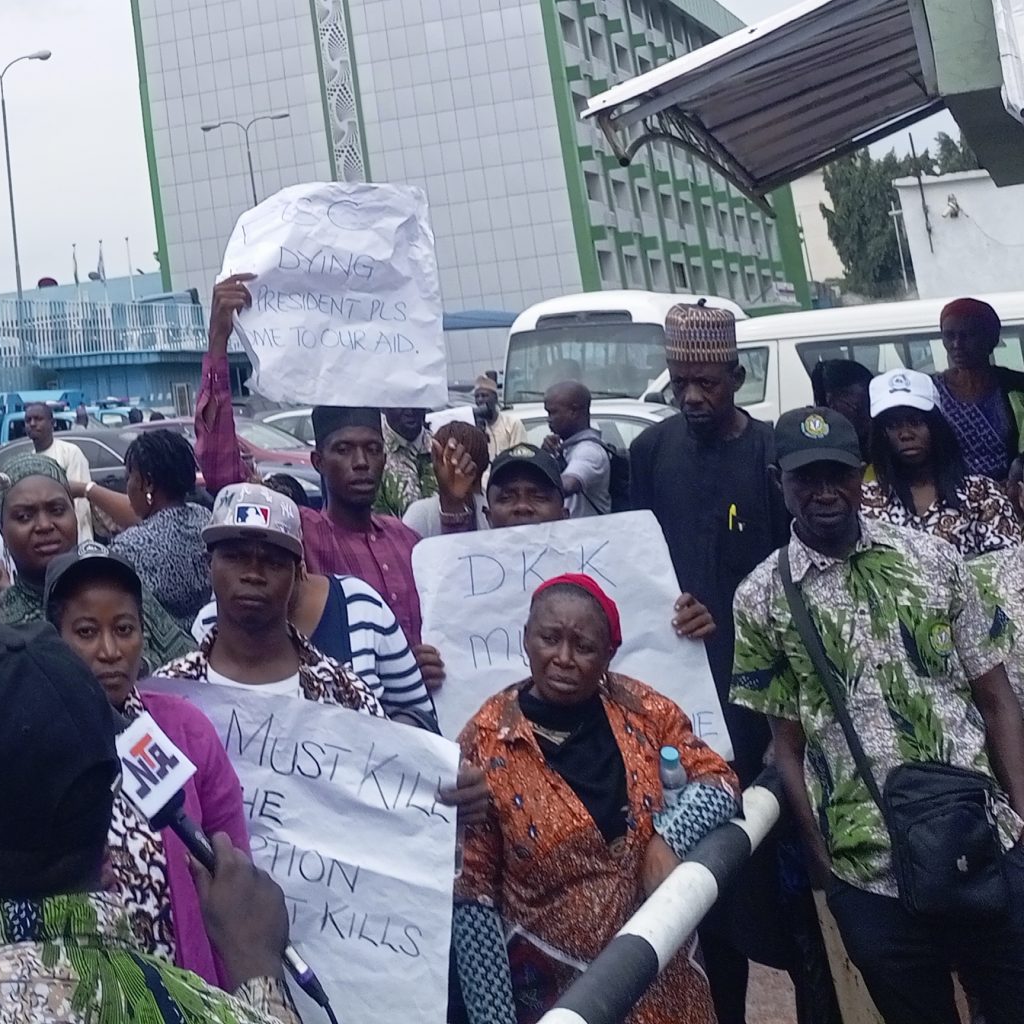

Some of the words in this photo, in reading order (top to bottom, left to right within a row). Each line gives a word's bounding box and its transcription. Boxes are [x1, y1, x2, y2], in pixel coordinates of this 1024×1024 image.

[279, 245, 376, 280] DYING
[257, 284, 361, 320] PRESIDENT
[370, 298, 407, 322] PLS
[290, 327, 317, 350] TO
[320, 328, 365, 351] OUR
[376, 331, 419, 355] AID.
[121, 732, 180, 800] NTA
[226, 709, 352, 781] MUST
[359, 742, 450, 823] KILL
[241, 787, 285, 826] HE
[251, 834, 360, 893] PTION
[320, 901, 423, 958] KILLS
